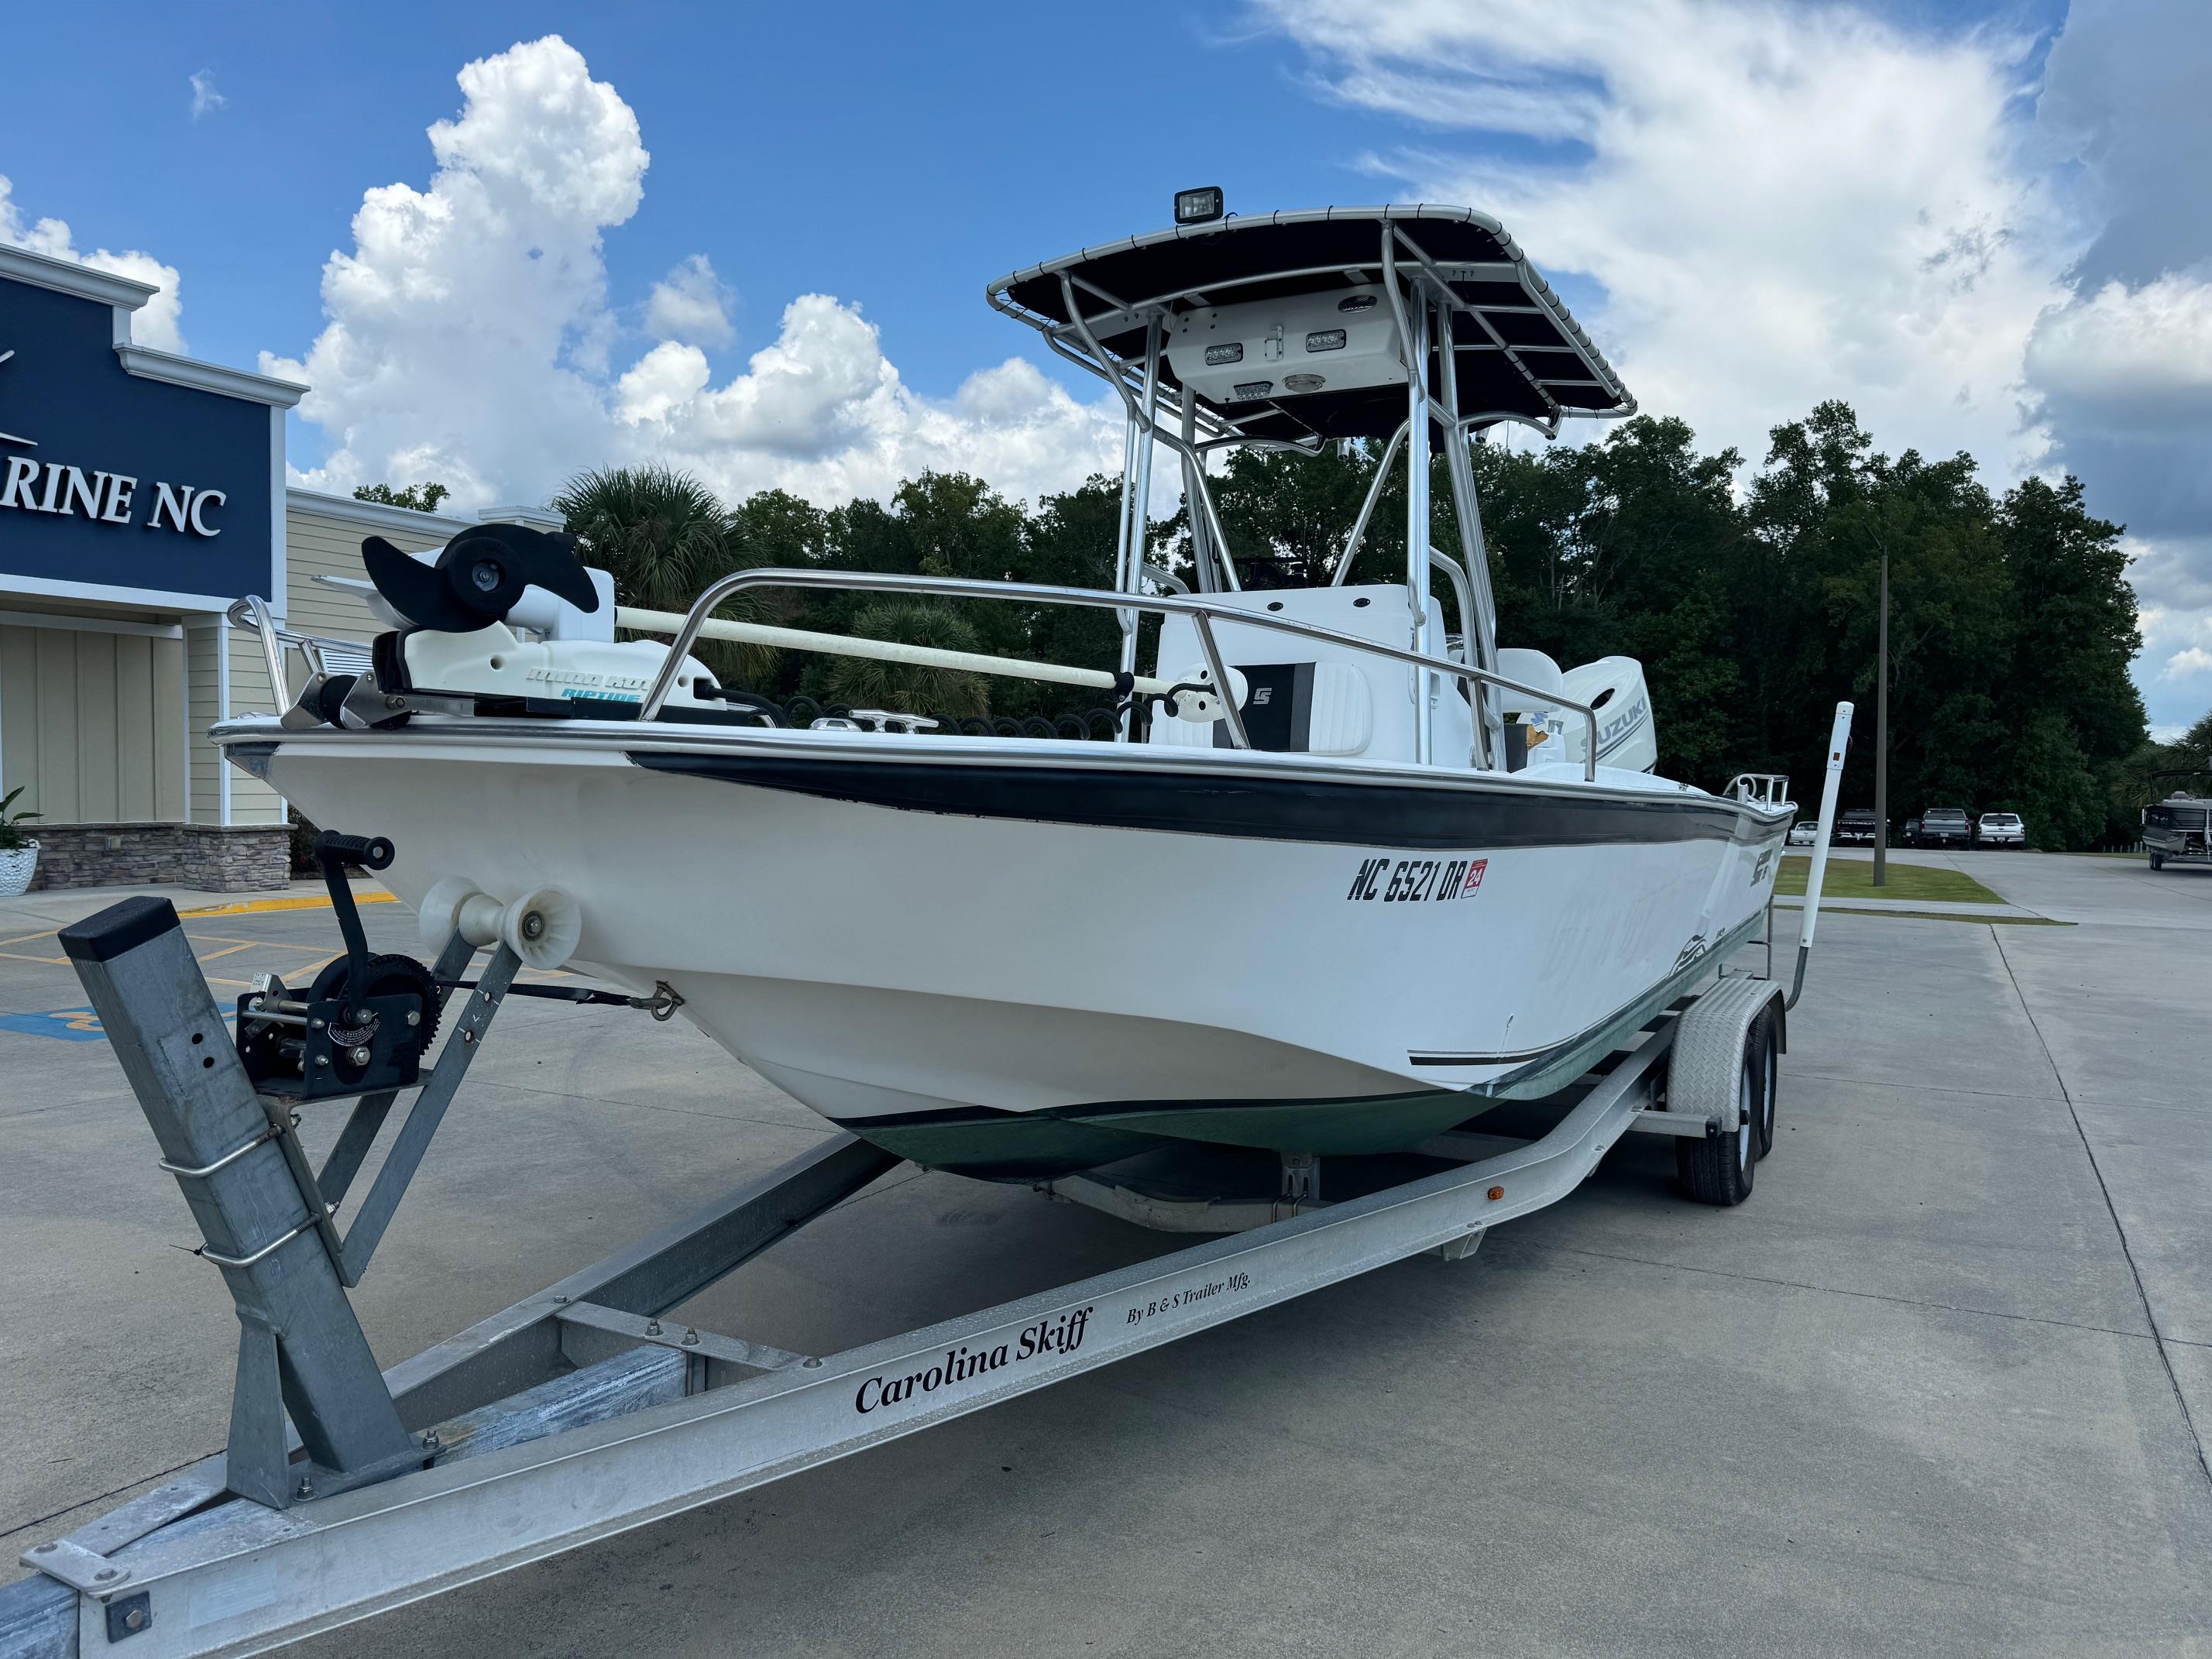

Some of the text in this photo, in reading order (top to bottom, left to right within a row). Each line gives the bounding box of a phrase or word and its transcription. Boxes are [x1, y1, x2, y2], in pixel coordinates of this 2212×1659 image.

[0, 456, 226, 537] RINE NC
[561, 688, 641, 702] RIPTIDE
[605, 675, 655, 690] KOT
[1347, 859, 1468, 902] NC 6521 DR
[1466, 868, 1483, 887] 24
[1126, 1272, 1251, 1325] By B & S Trailer Mfg.
[855, 1306, 1094, 1414] Carolina Skiff
